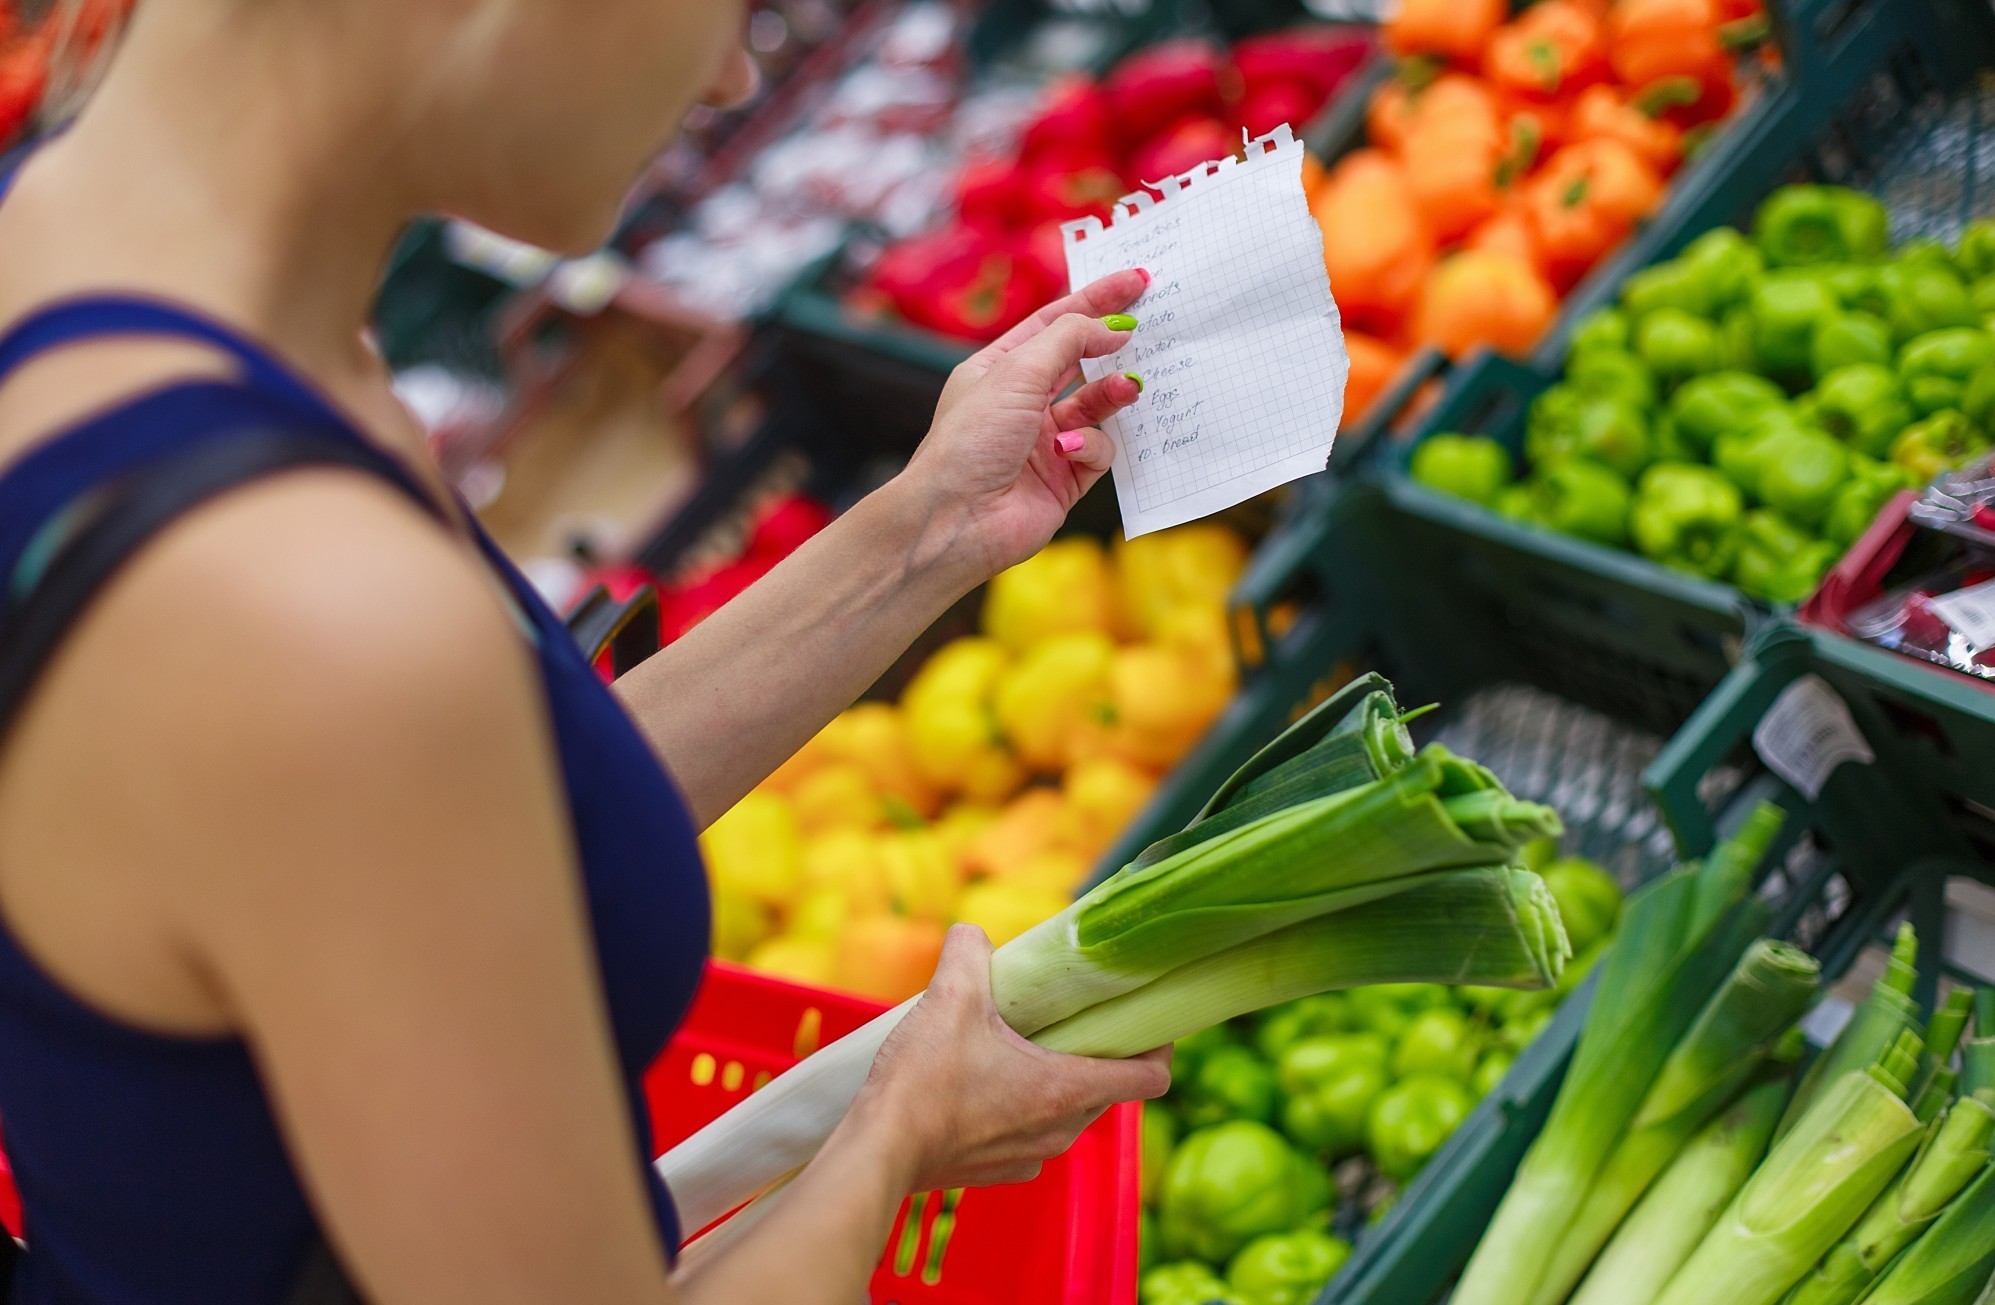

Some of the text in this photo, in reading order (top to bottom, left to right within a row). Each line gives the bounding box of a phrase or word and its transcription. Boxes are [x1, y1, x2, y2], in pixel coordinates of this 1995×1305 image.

[1126, 281, 1182, 311] arrots
[1138, 309, 1175, 333] otato
[1135, 337, 1176, 363] Water
[1142, 356, 1196, 383] Cheese
[1151, 388, 1180, 412] Eggs
[1156, 400, 1204, 435] Yogurt
